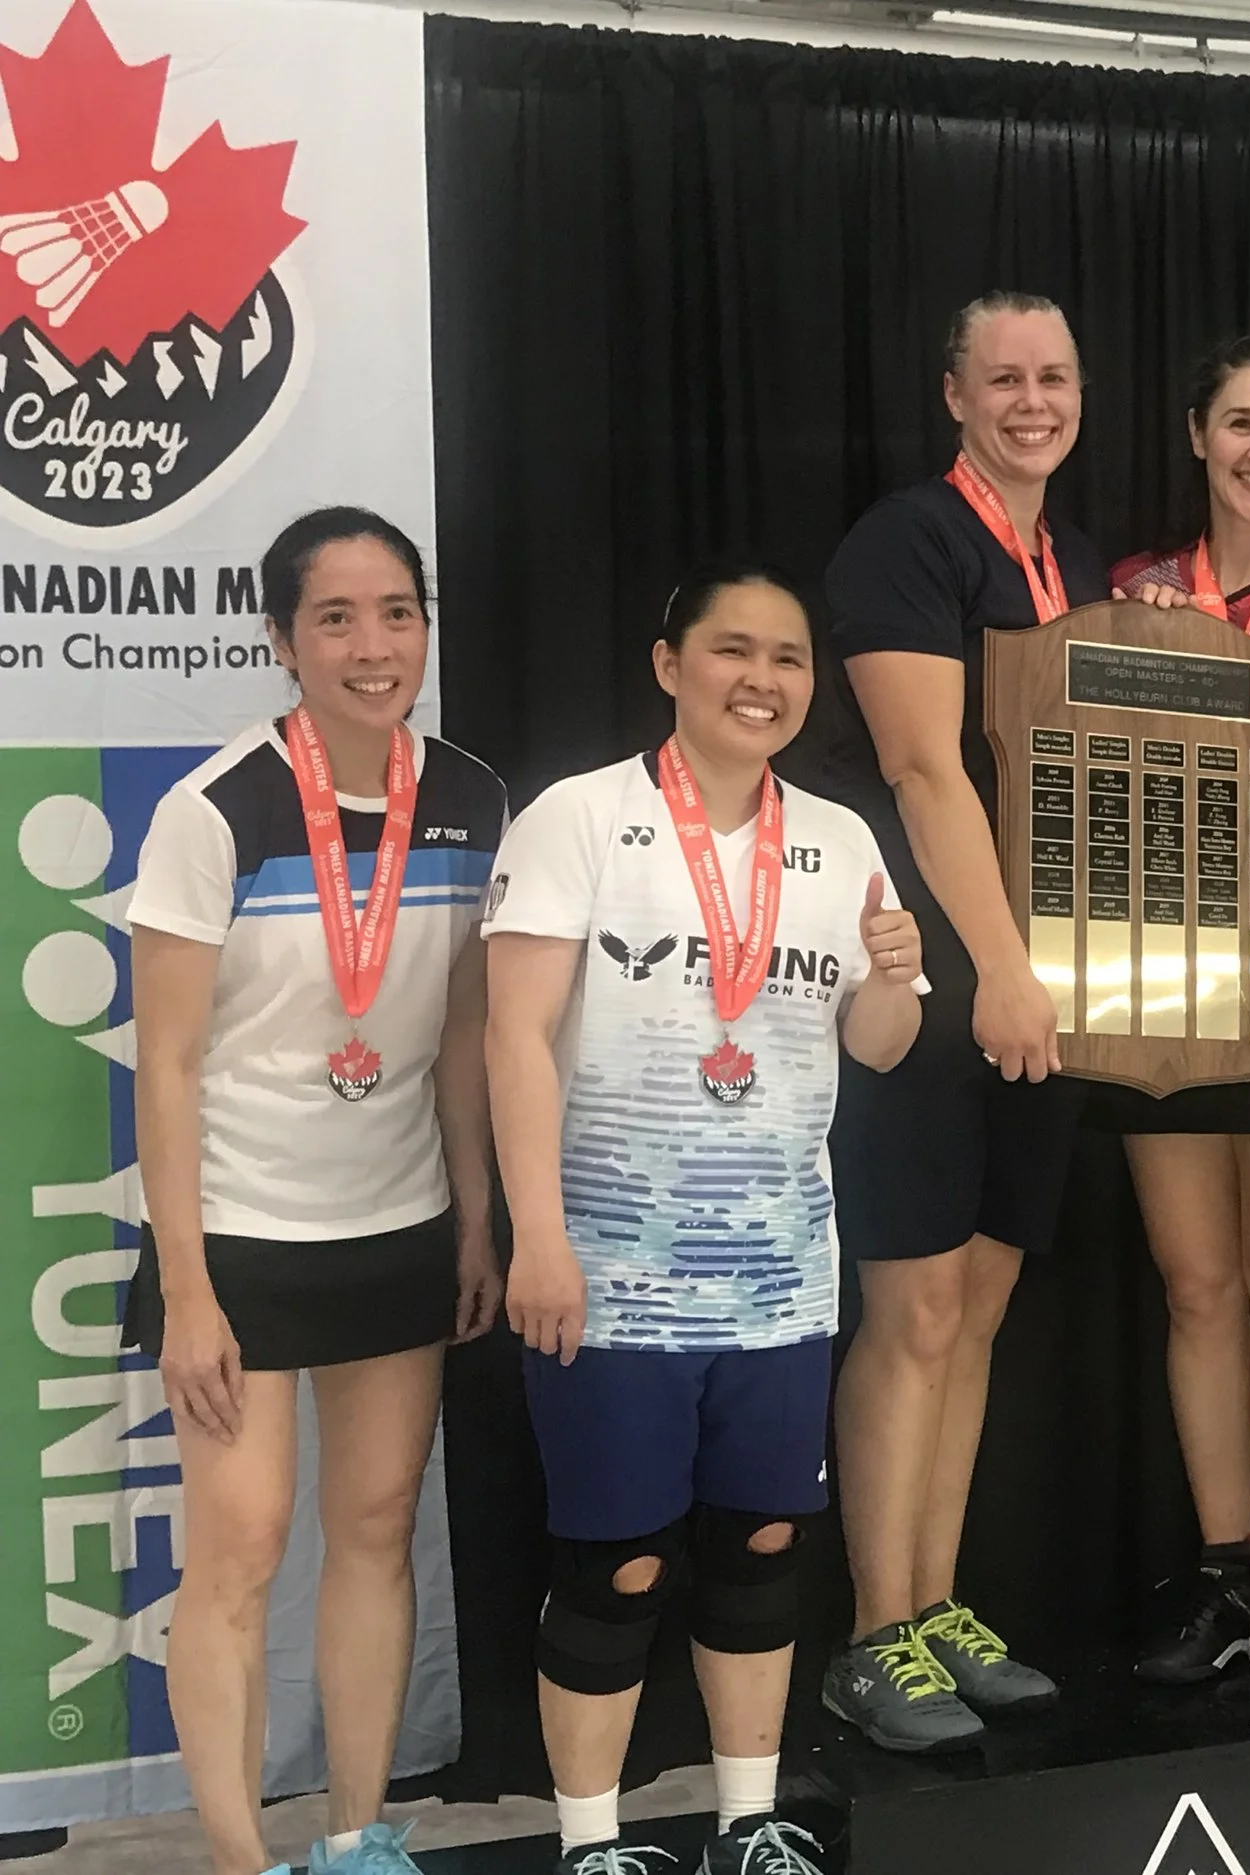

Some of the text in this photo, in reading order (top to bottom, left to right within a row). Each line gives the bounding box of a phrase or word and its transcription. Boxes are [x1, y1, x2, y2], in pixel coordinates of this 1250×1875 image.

[4, 392, 188, 474] Calgary
[44, 459, 153, 500] 2023
[1105, 668, 1132, 679] OPEN
[1136, 671, 1185, 684] MASTERS
[1123, 655, 1176, 671] BADMINTON
[1080, 686, 1246, 711] THE HOLLYBURN CLUB AWARD
[308, 747, 329, 792] MASTERS
[676, 770, 698, 808] MASTERS
[328, 840, 342, 876] YONEX
[334, 877, 352, 929] CANADIAN
[364, 886, 387, 939] CANADIAN
[379, 840, 395, 886] MASTERS
[747, 909, 764, 956] CANADIAN
[756, 868, 768, 908] MASTERS
[701, 849, 736, 979] YONEX CANADIAN MASTERS
[685, 936, 840, 988] FING
